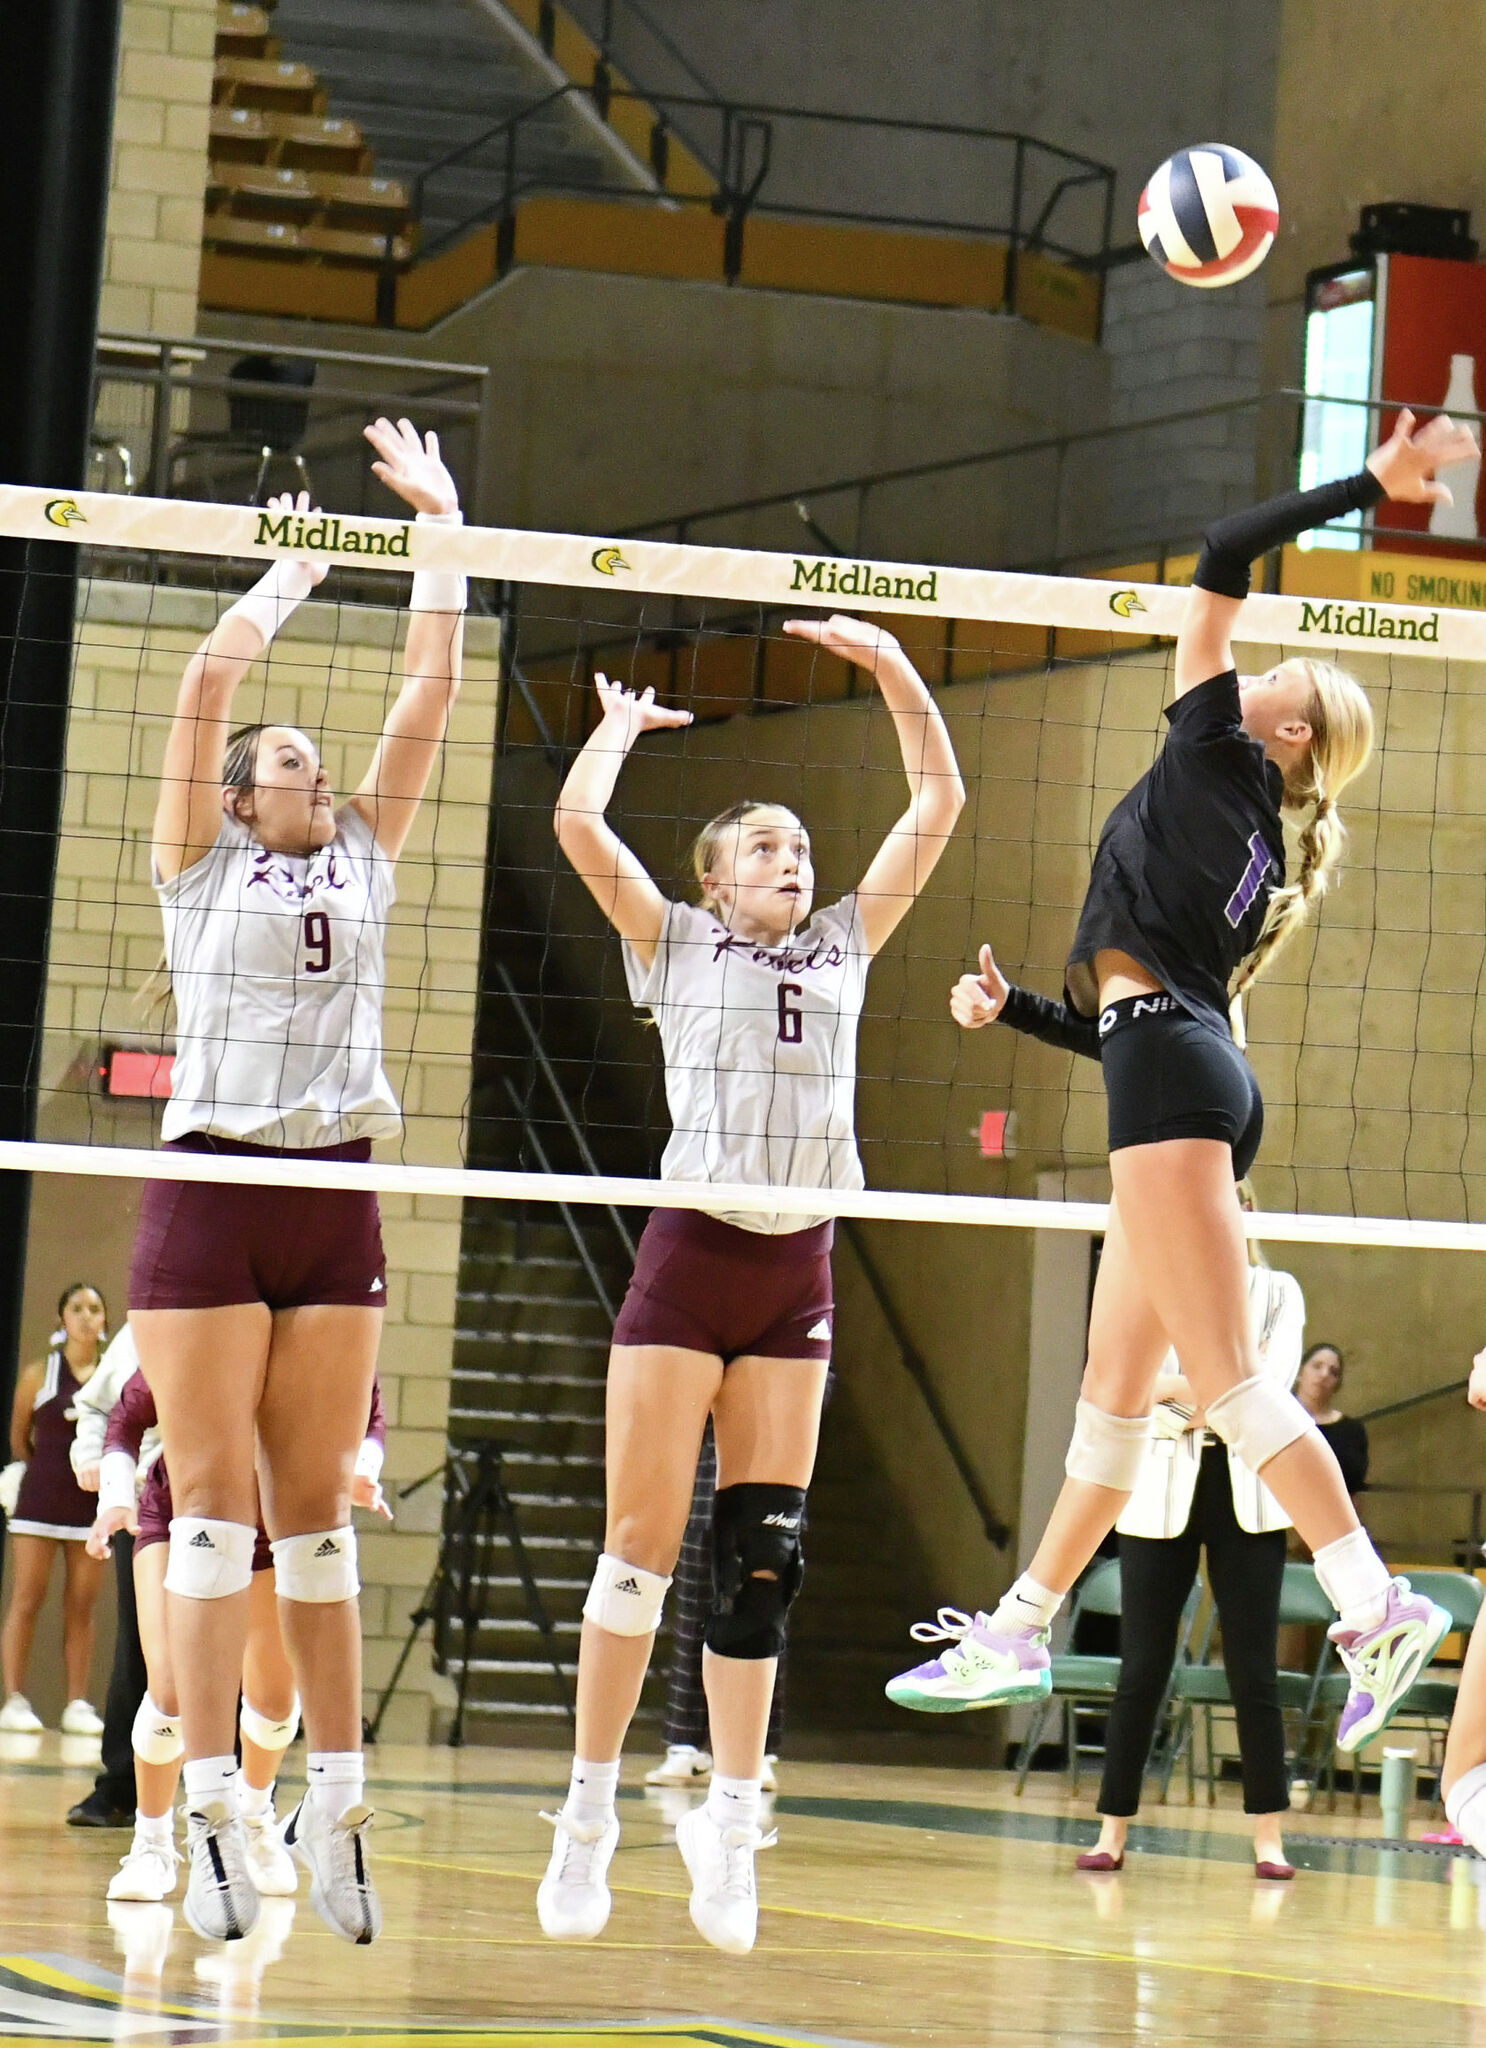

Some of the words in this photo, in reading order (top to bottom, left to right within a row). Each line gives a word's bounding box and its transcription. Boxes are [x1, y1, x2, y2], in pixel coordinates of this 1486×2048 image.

[254, 513, 410, 557] Midland
[790, 559, 938, 602] Midland
[1371, 571, 1395, 599] NO
[1298, 601, 1439, 642] Midland
[304, 912, 331, 973] 9
[777, 983, 803, 1043] 6
